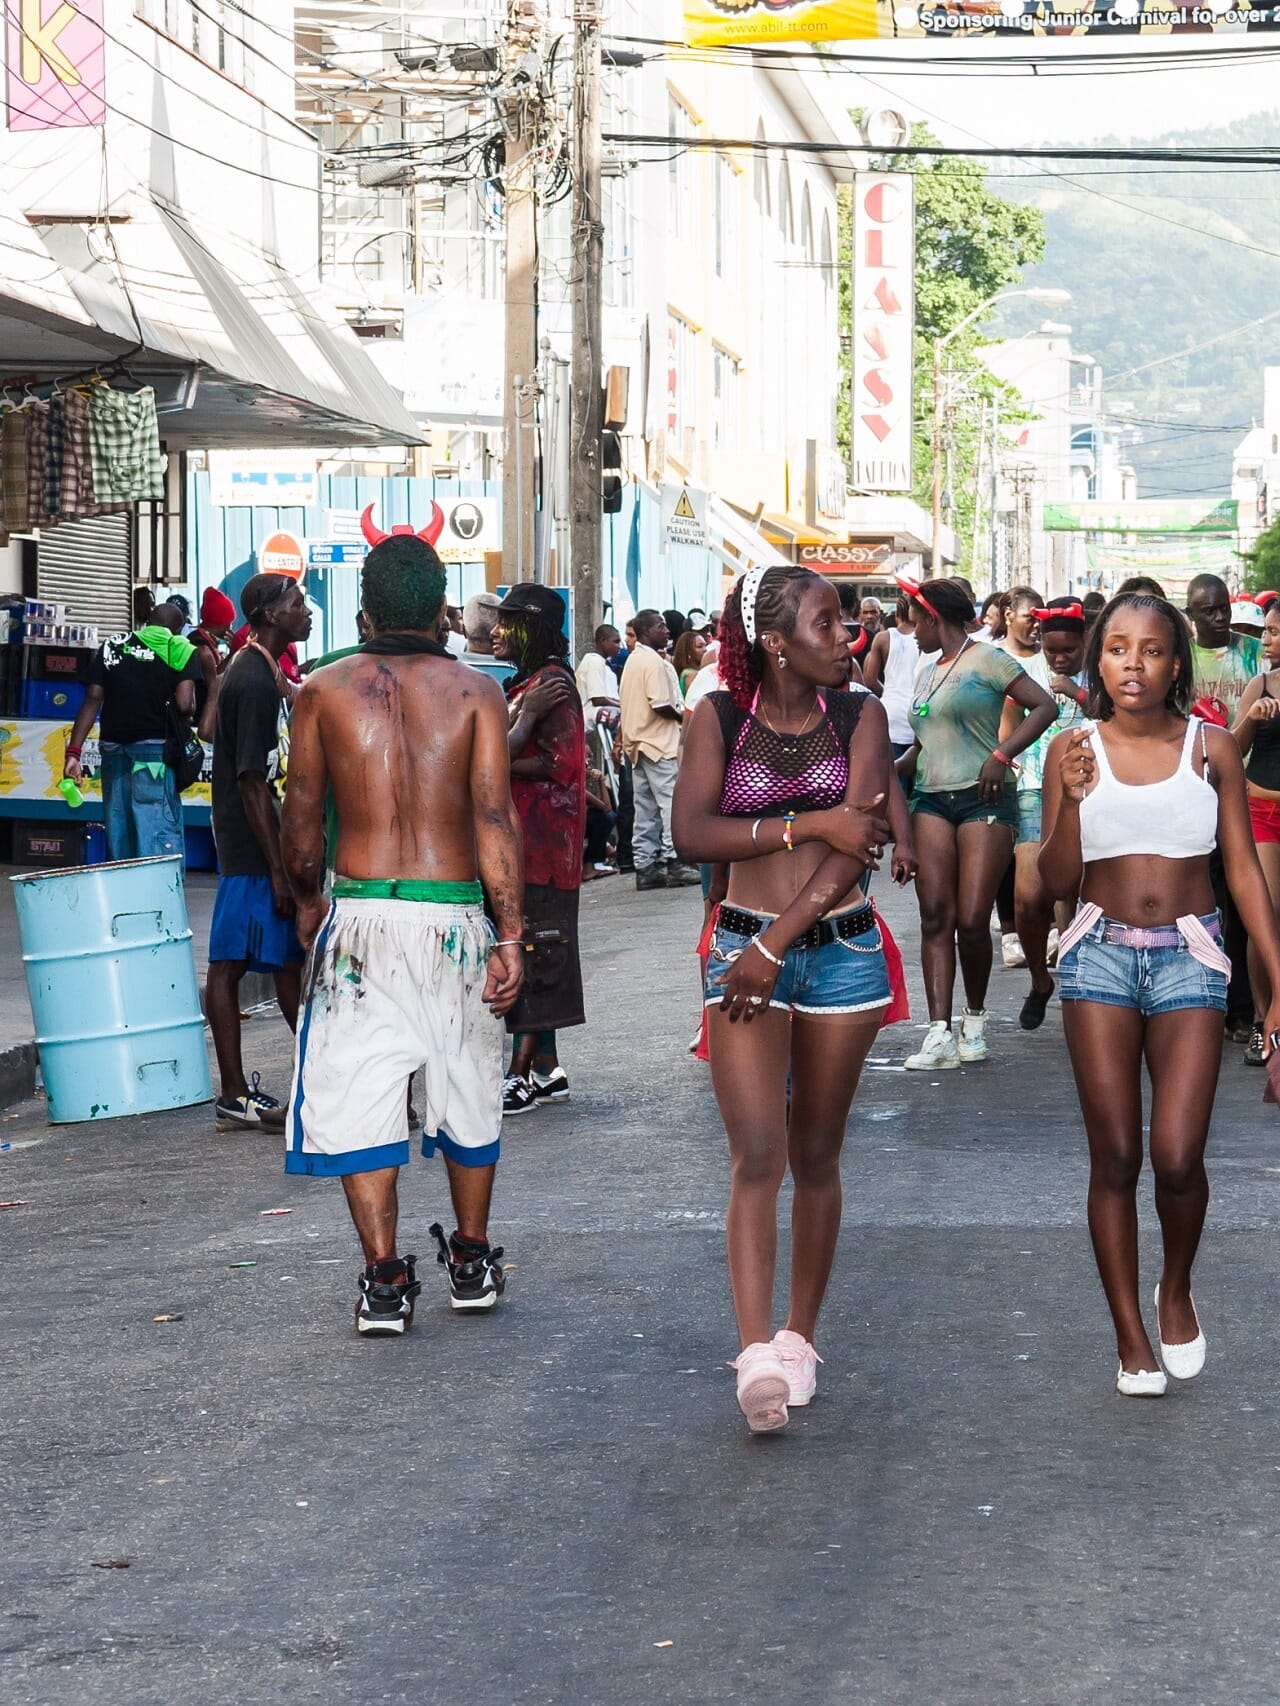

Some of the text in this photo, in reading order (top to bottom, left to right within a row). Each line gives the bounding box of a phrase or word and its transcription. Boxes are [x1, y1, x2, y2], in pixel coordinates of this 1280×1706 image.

[919, 11, 1033, 31] Sponsoring
[1039, 9, 1102, 27] Junior
[1106, 7, 1187, 26] Carnival
[1192, 6, 1220, 24] for
[1223, 9, 1270, 24] over
[725, 21, 828, 33] www.abil-tt.com
[859, 182, 904, 444] CLASSY
[670, 517, 701, 527] CAUTION
[666, 525, 706, 538] PLEASE USE
[670, 536, 704, 546] WALKWAY
[802, 544, 889, 564] CLASSY
